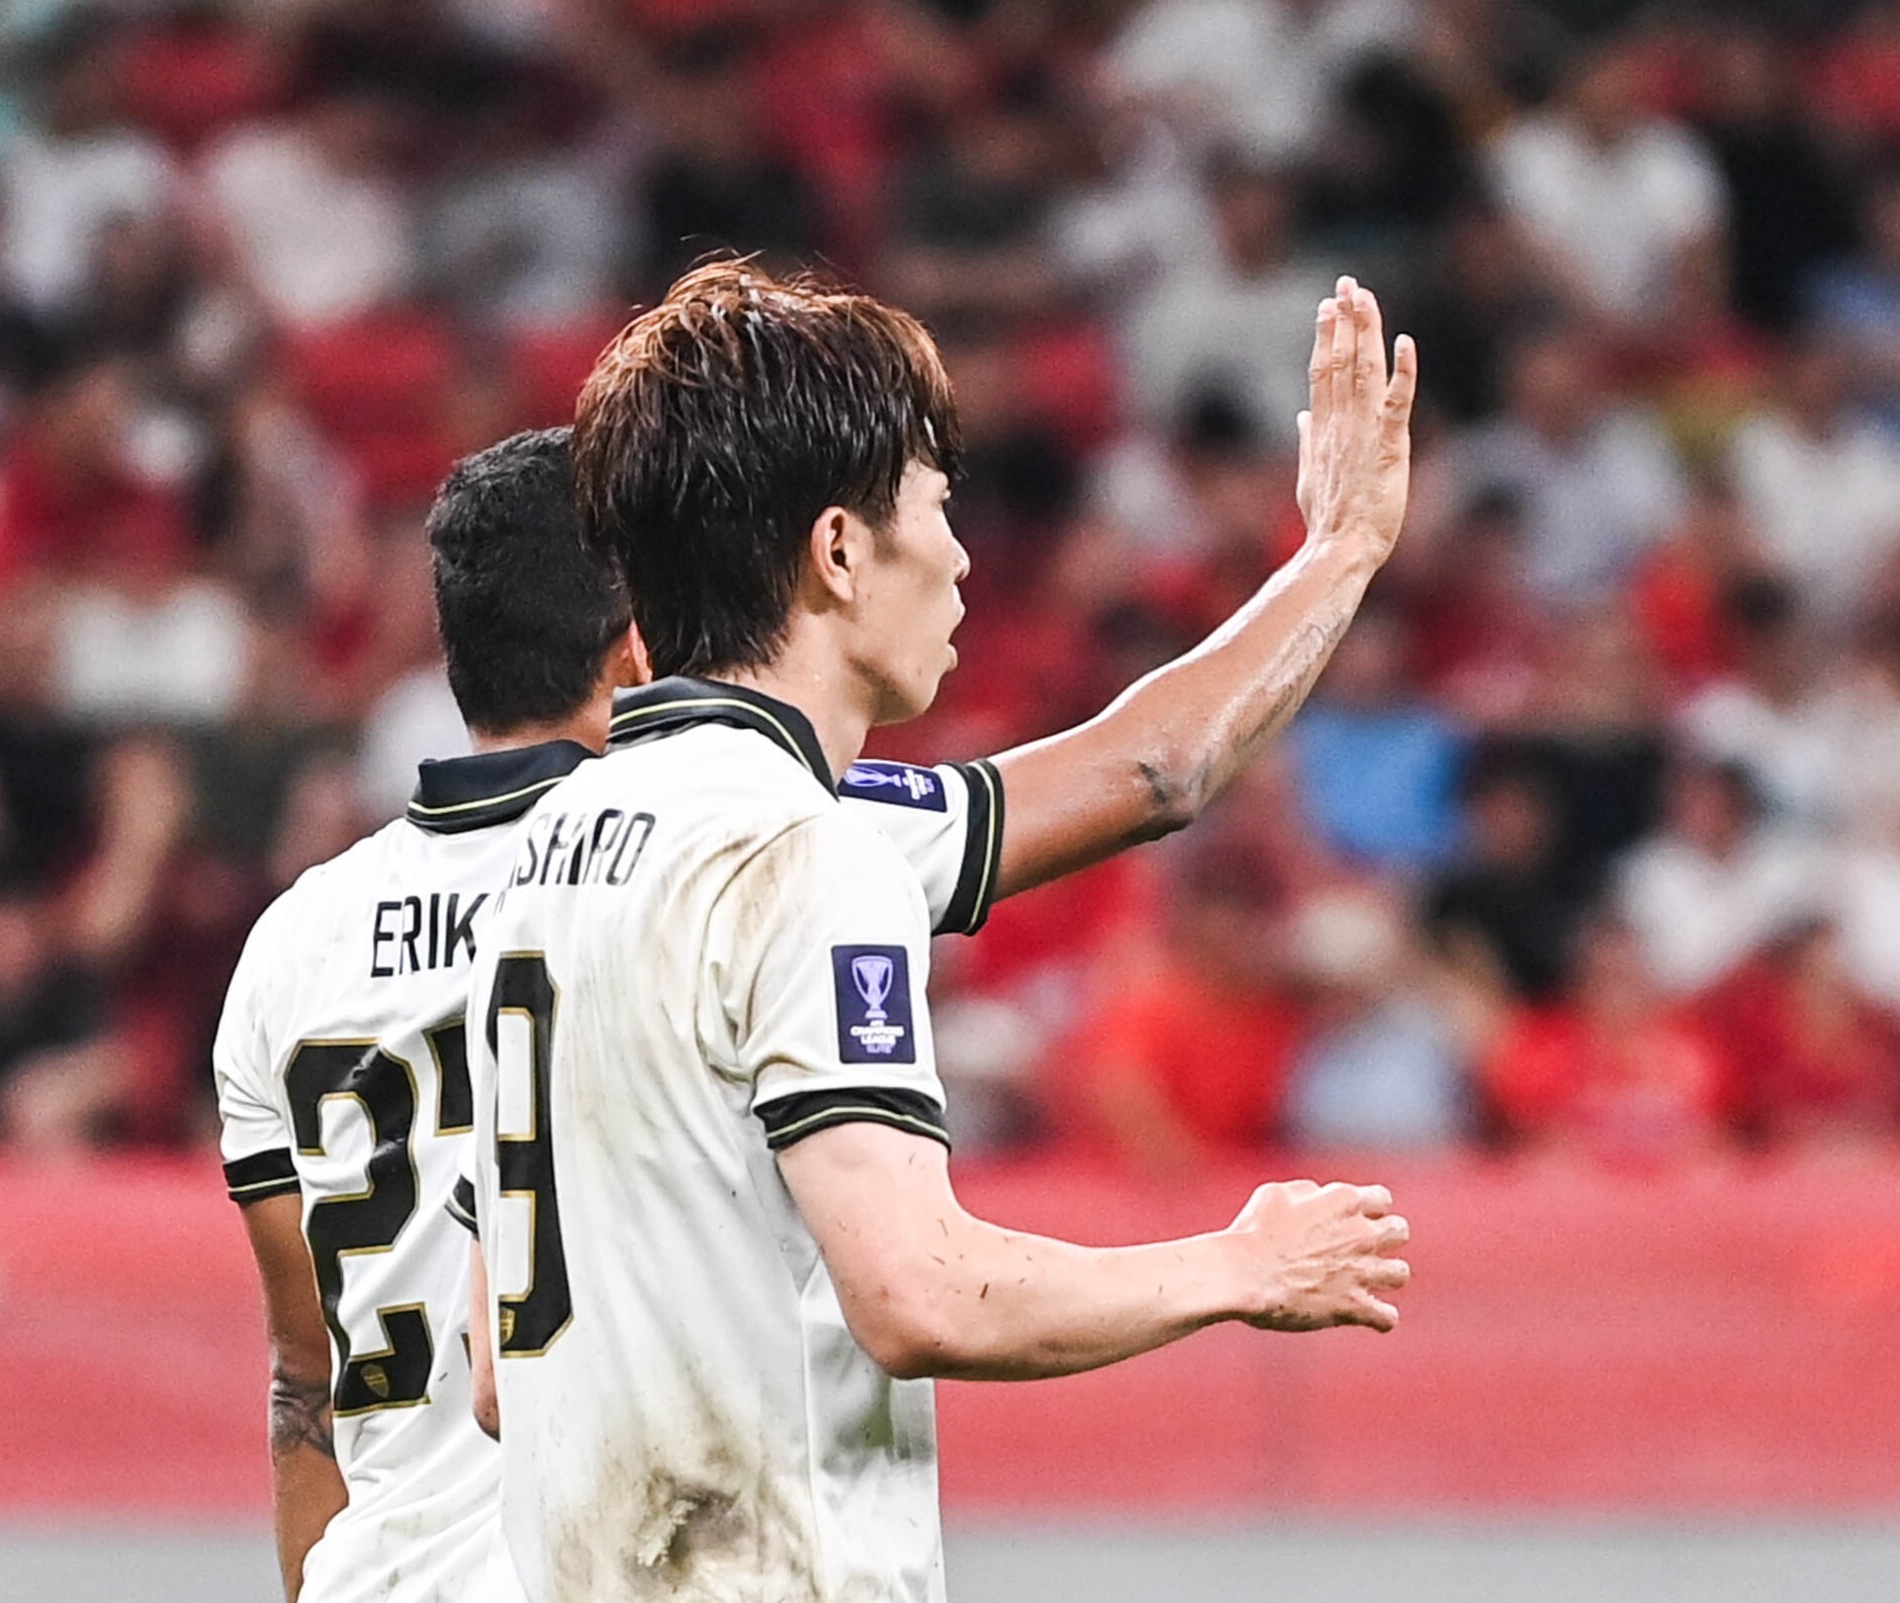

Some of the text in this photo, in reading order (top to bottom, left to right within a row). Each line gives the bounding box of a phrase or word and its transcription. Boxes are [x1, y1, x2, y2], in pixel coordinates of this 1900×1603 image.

[504, 808, 657, 890] SHIRO
[370, 892, 490, 979] ERIK
[283, 1018, 475, 1419] 2
